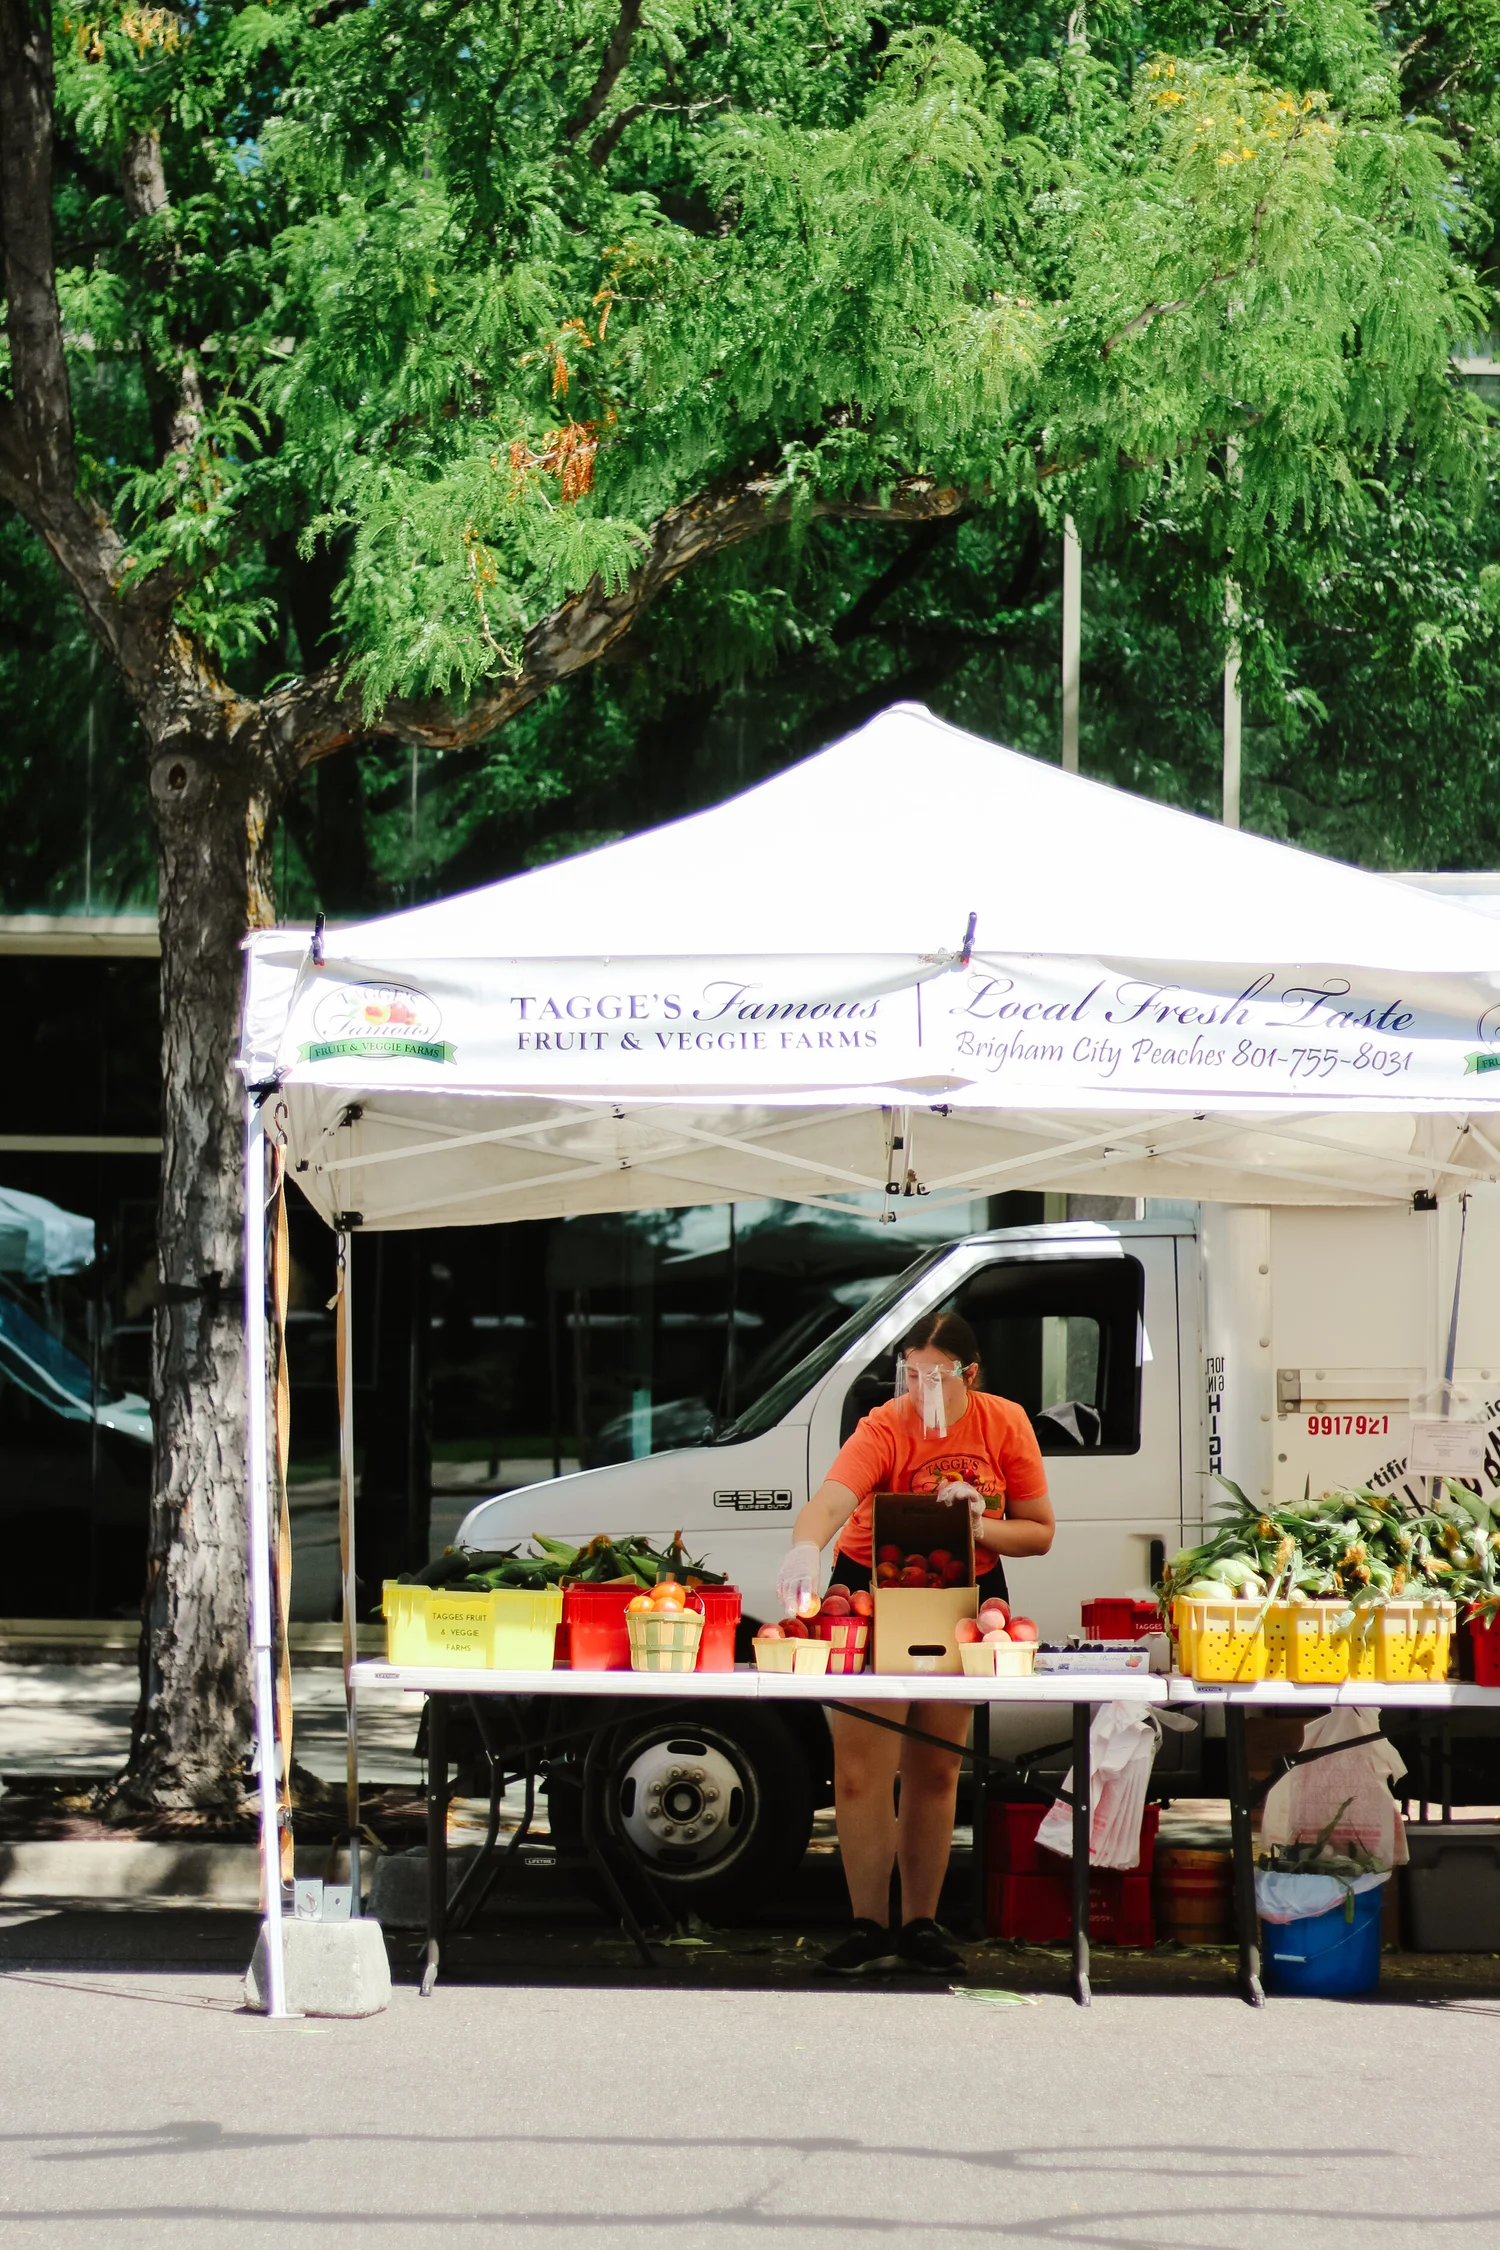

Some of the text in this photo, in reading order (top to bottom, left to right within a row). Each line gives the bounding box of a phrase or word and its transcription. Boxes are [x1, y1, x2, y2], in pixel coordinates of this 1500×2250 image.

[510, 981, 884, 1021] TAGGE'S Famous
[949, 972, 1415, 1031] Local Fresh Taste
[323, 1014, 430, 1036] Famous
[315, 1042, 440, 1058] FRUIT & VEGGIE FARMS
[518, 1030, 878, 1051] FRUIT & VEGGIE FARMS
[956, 1029, 1414, 1079] Brigham City Peaches 801-755-8031
[1308, 1415, 1389, 1436] 9917921
[926, 1458, 979, 1476] TAGGE'S
[432, 1612, 487, 1622] TAGGES FRUIT
[440, 1628, 480, 1637] & VEGGIE
[446, 1643, 472, 1652] FARMS
